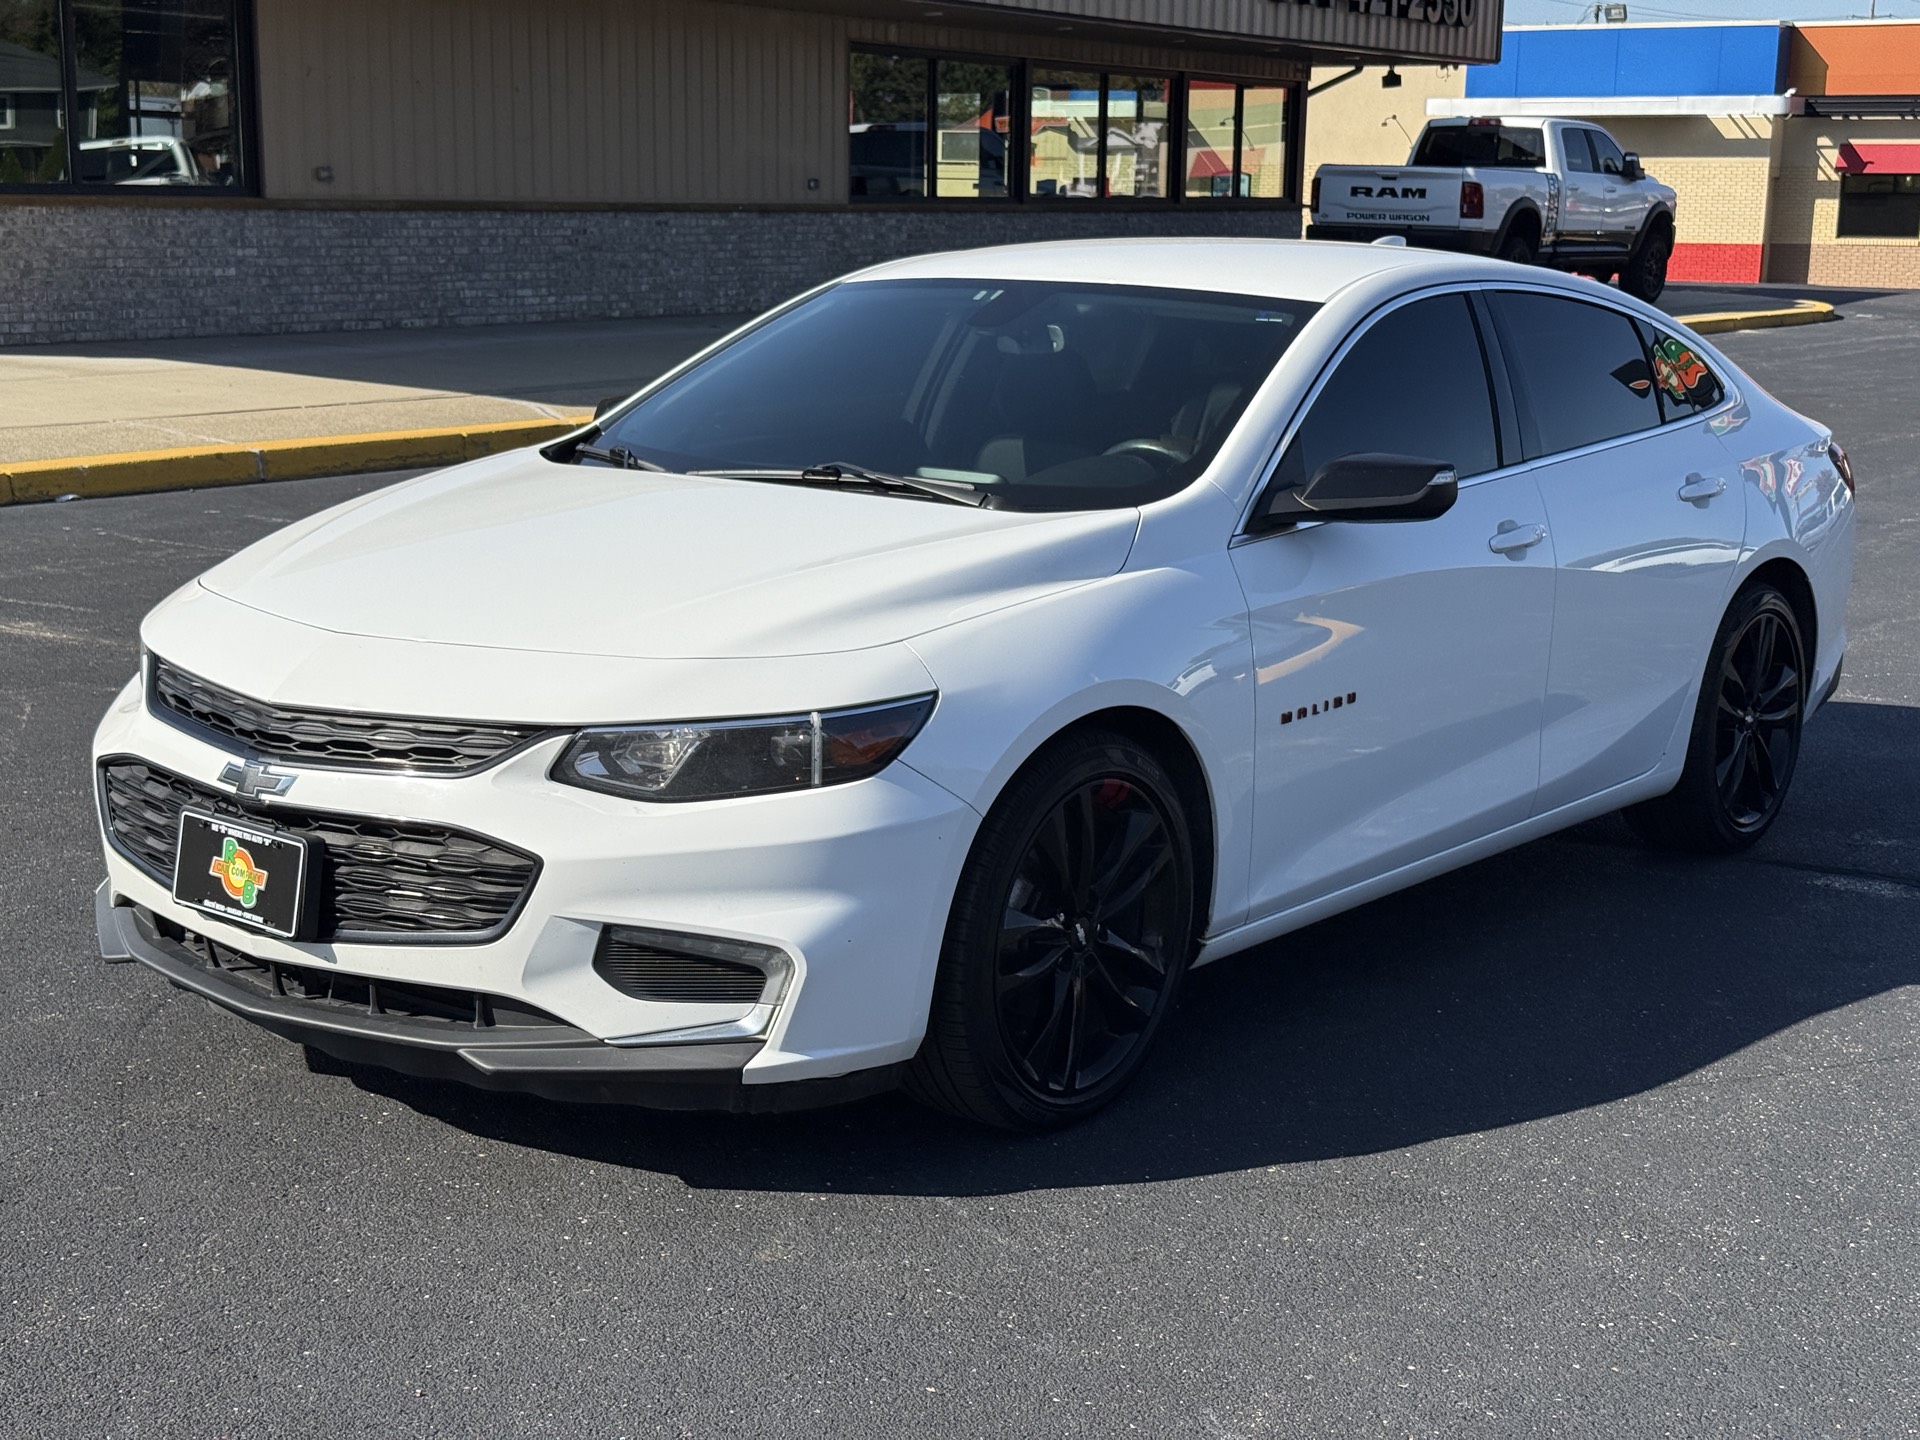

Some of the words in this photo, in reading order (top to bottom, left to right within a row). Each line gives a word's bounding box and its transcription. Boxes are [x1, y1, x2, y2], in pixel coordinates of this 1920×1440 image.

[1350, 186, 1427, 199] RAM
[1346, 212, 1386, 221] POWER
[1389, 214, 1430, 222] WAGON
[1280, 692, 1357, 725] MALIBU
[224, 839, 237, 865] R
[243, 880, 255, 904] B
